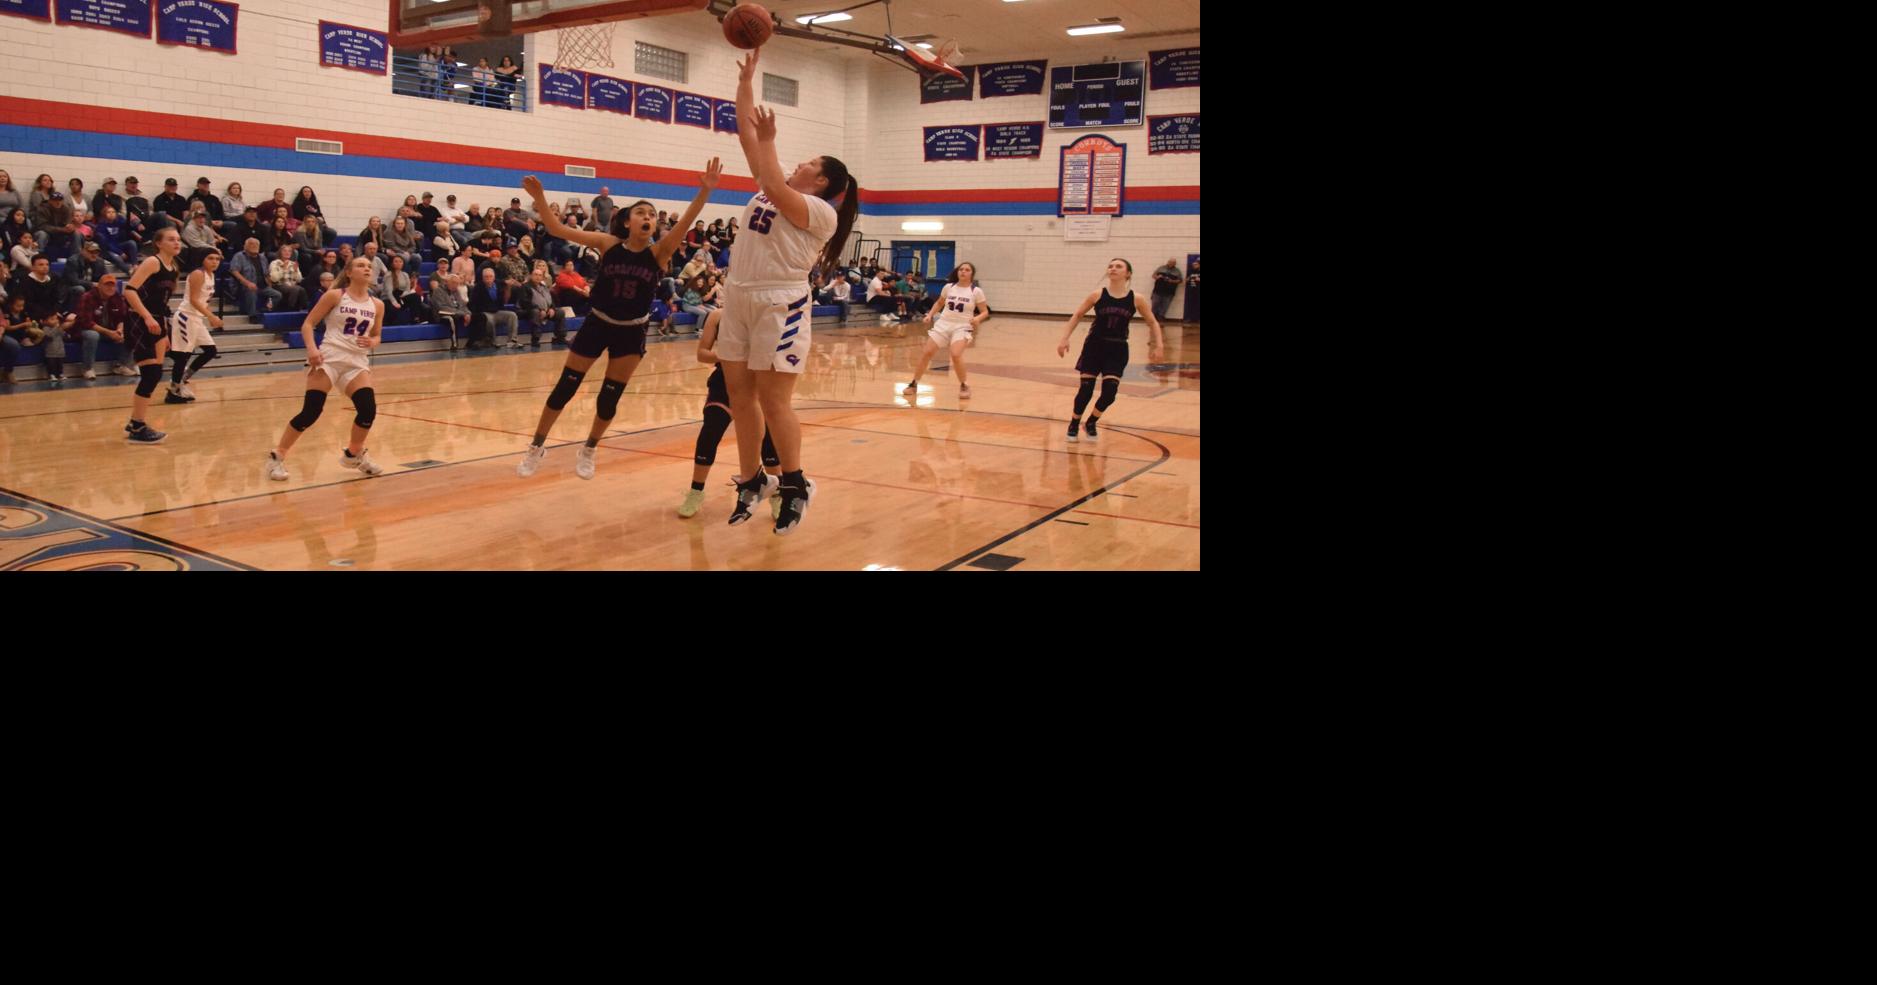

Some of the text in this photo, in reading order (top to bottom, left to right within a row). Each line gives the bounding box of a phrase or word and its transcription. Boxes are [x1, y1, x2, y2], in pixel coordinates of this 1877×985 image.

[163, 4, 175, 14] CAMP
[1116, 78, 1138, 86] GUEST
[1156, 120, 1172, 132] CAMP
[748, 206, 776, 235] 25
[612, 279, 637, 299] 15
[340, 306, 376, 318] CAMP VERDE
[948, 301, 964, 312] 34
[343, 316, 370, 337] 24
